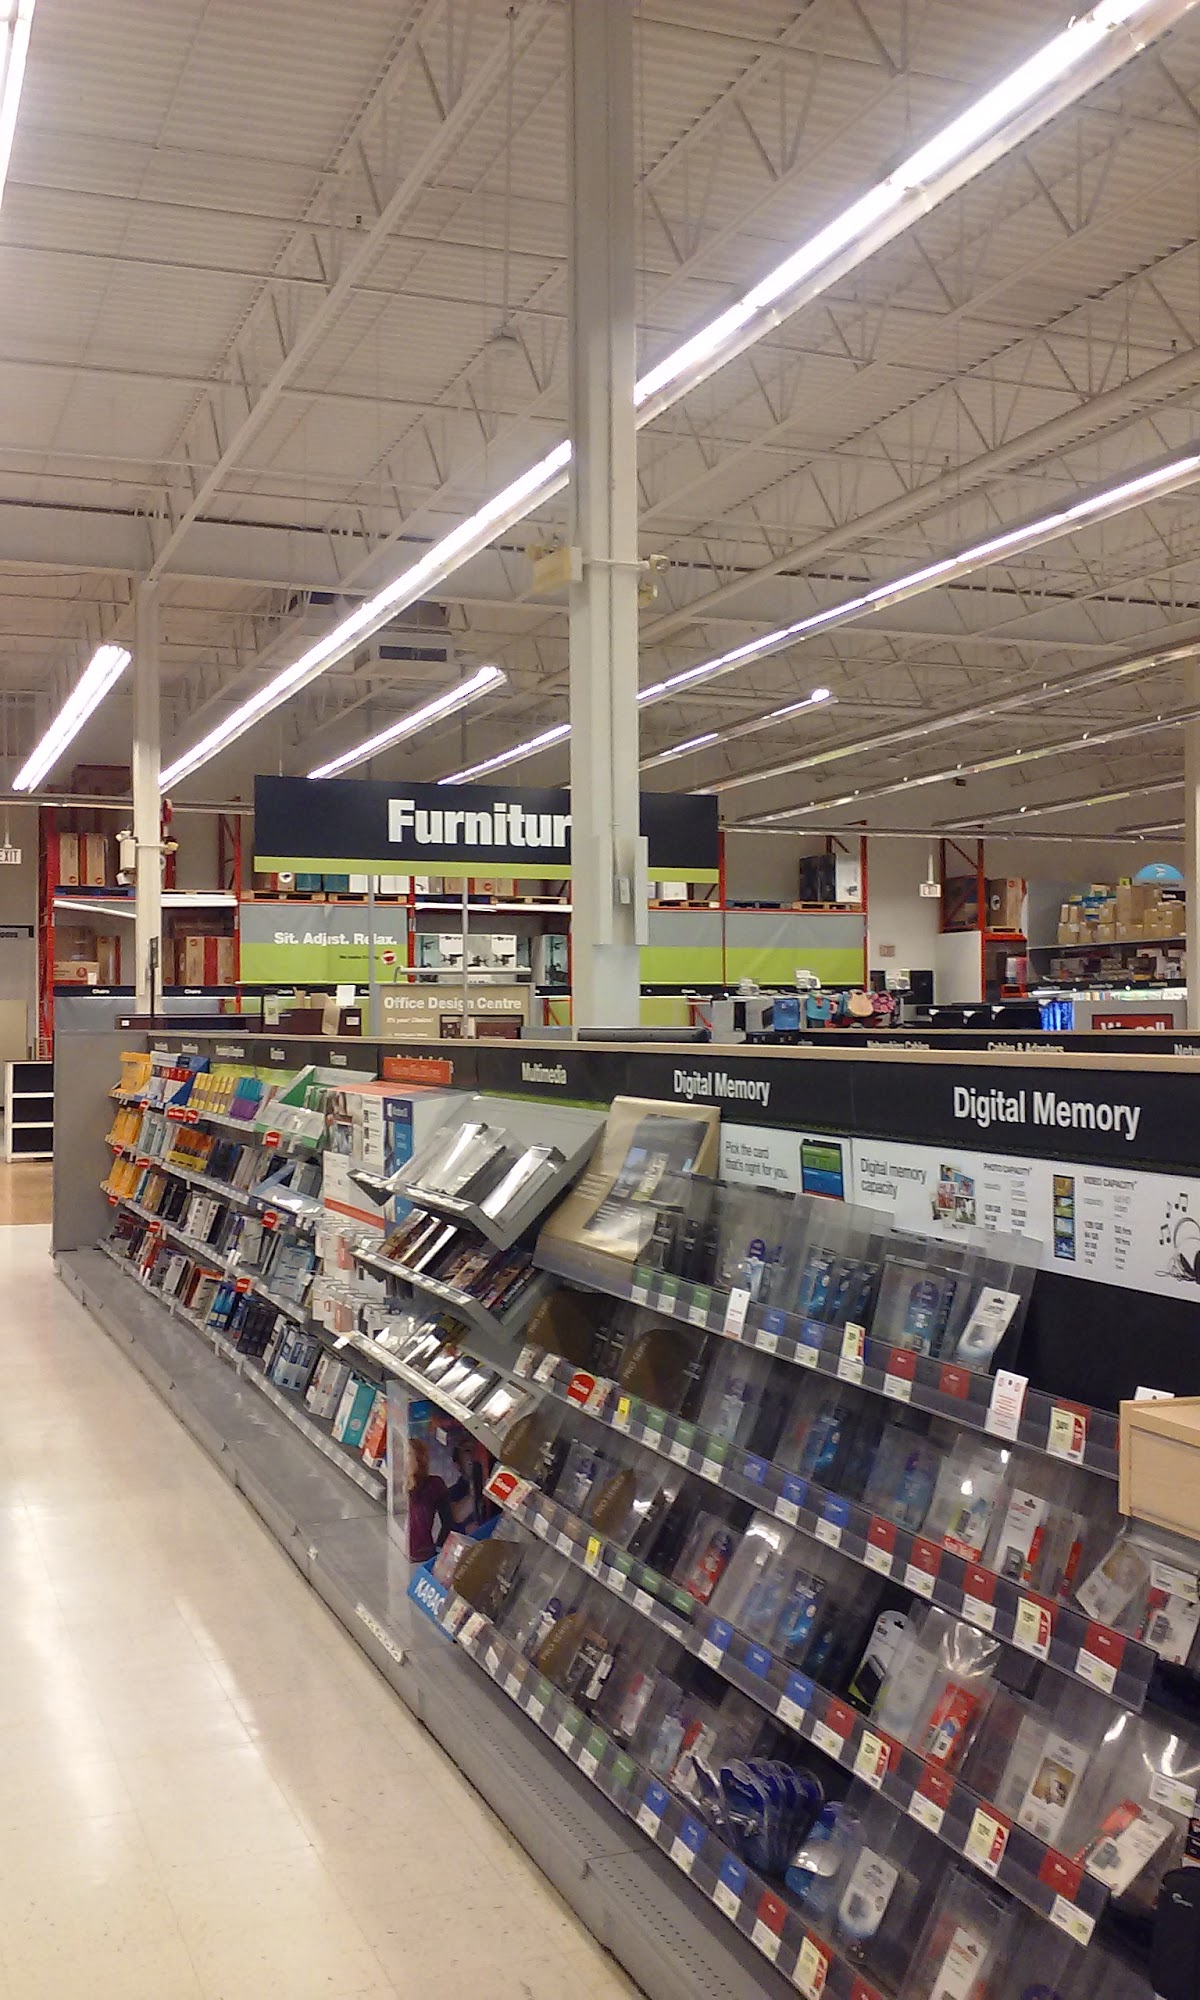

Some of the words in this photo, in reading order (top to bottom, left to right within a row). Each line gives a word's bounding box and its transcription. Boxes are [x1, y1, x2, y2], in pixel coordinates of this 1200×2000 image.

[388, 799, 572, 848] Furnitur
[274, 931, 299, 945] Sit.
[384, 996, 425, 1009] Office
[477, 997, 522, 1009] Centre
[521, 1061, 568, 1085] Multimedia
[673, 1069, 713, 1100] Digital
[714, 1071, 771, 1107] Memory
[953, 1086, 1026, 1128] Digital
[1032, 1091, 1141, 1141] Memory
[860, 1157, 888, 1178] Digital
[889, 1165, 928, 1186] memory
[860, 1179, 899, 1201] capacity
[570, 1380, 590, 1395] Save
[493, 1477, 512, 1494] Save
